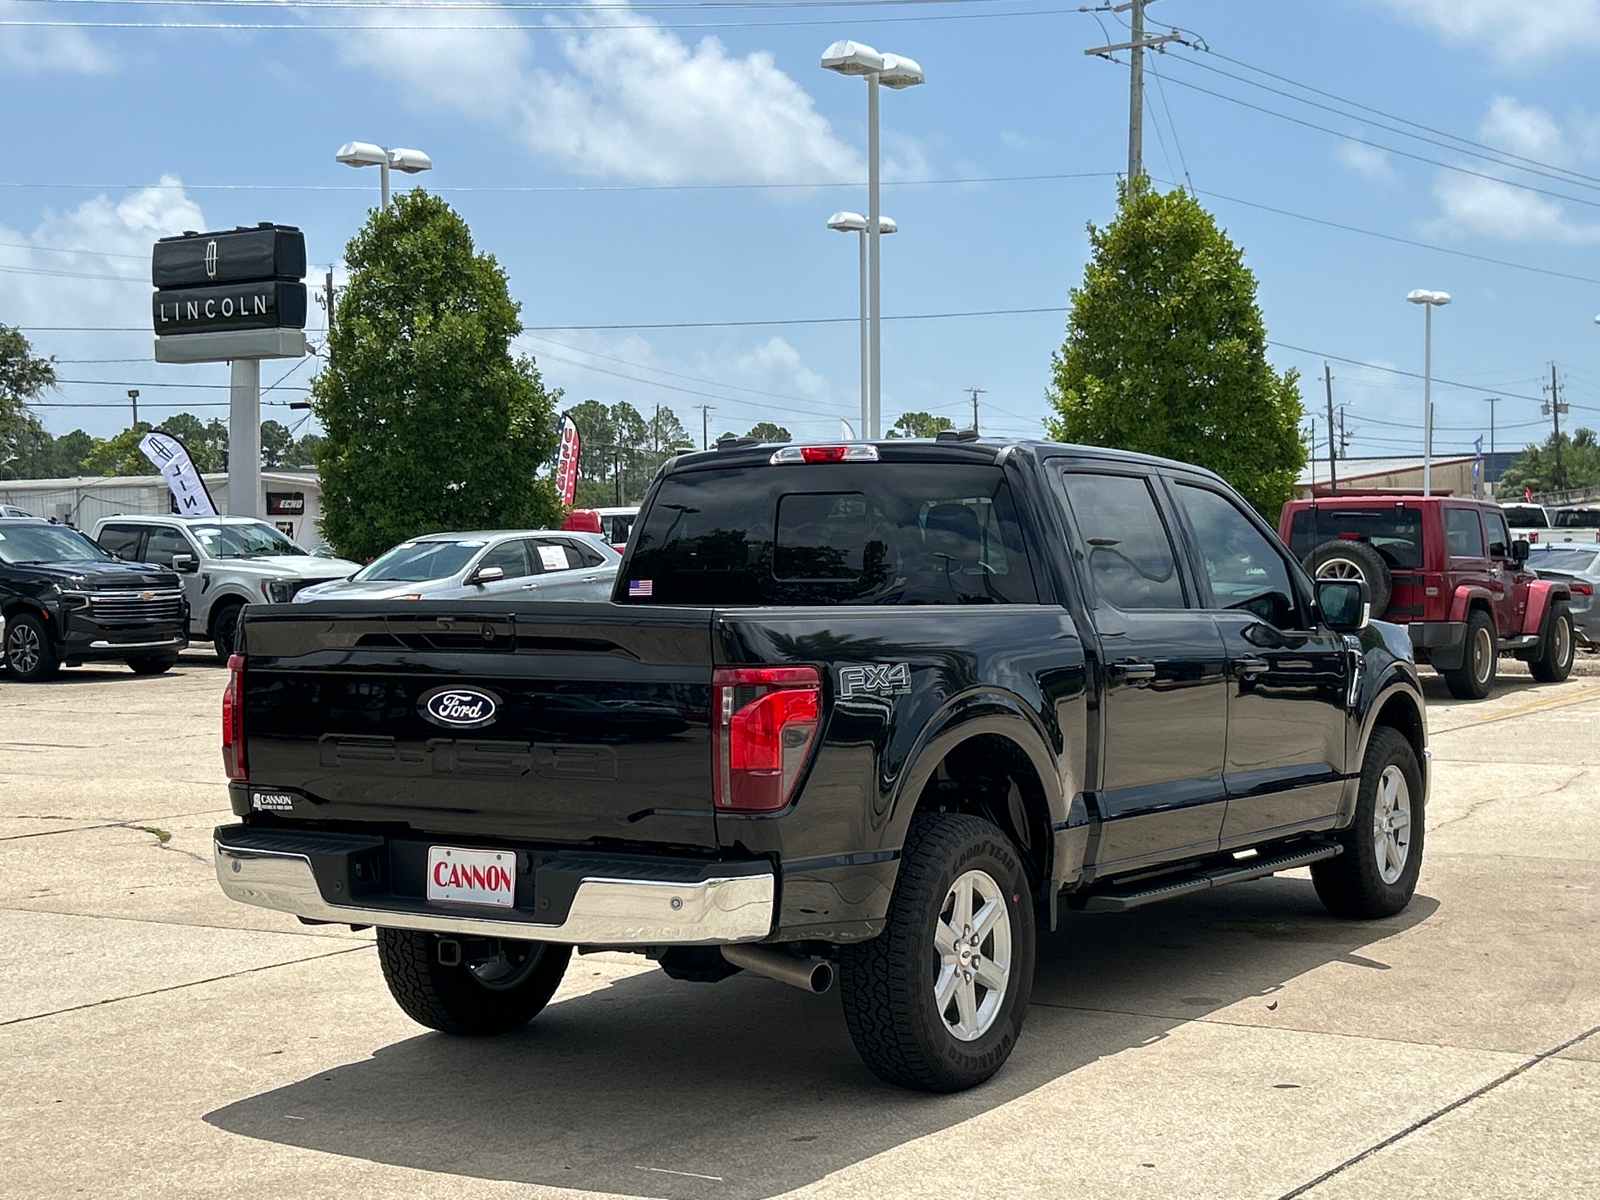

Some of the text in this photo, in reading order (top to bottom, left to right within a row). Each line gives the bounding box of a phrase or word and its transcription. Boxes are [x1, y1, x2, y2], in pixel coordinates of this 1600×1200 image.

[160, 295, 267, 322] LINCOLN
[278, 499, 304, 509] ECHO
[839, 662, 912, 700] FX4
[438, 693, 483, 719] Ford
[260, 794, 292, 805] CANNON
[433, 861, 512, 893] CANNON
